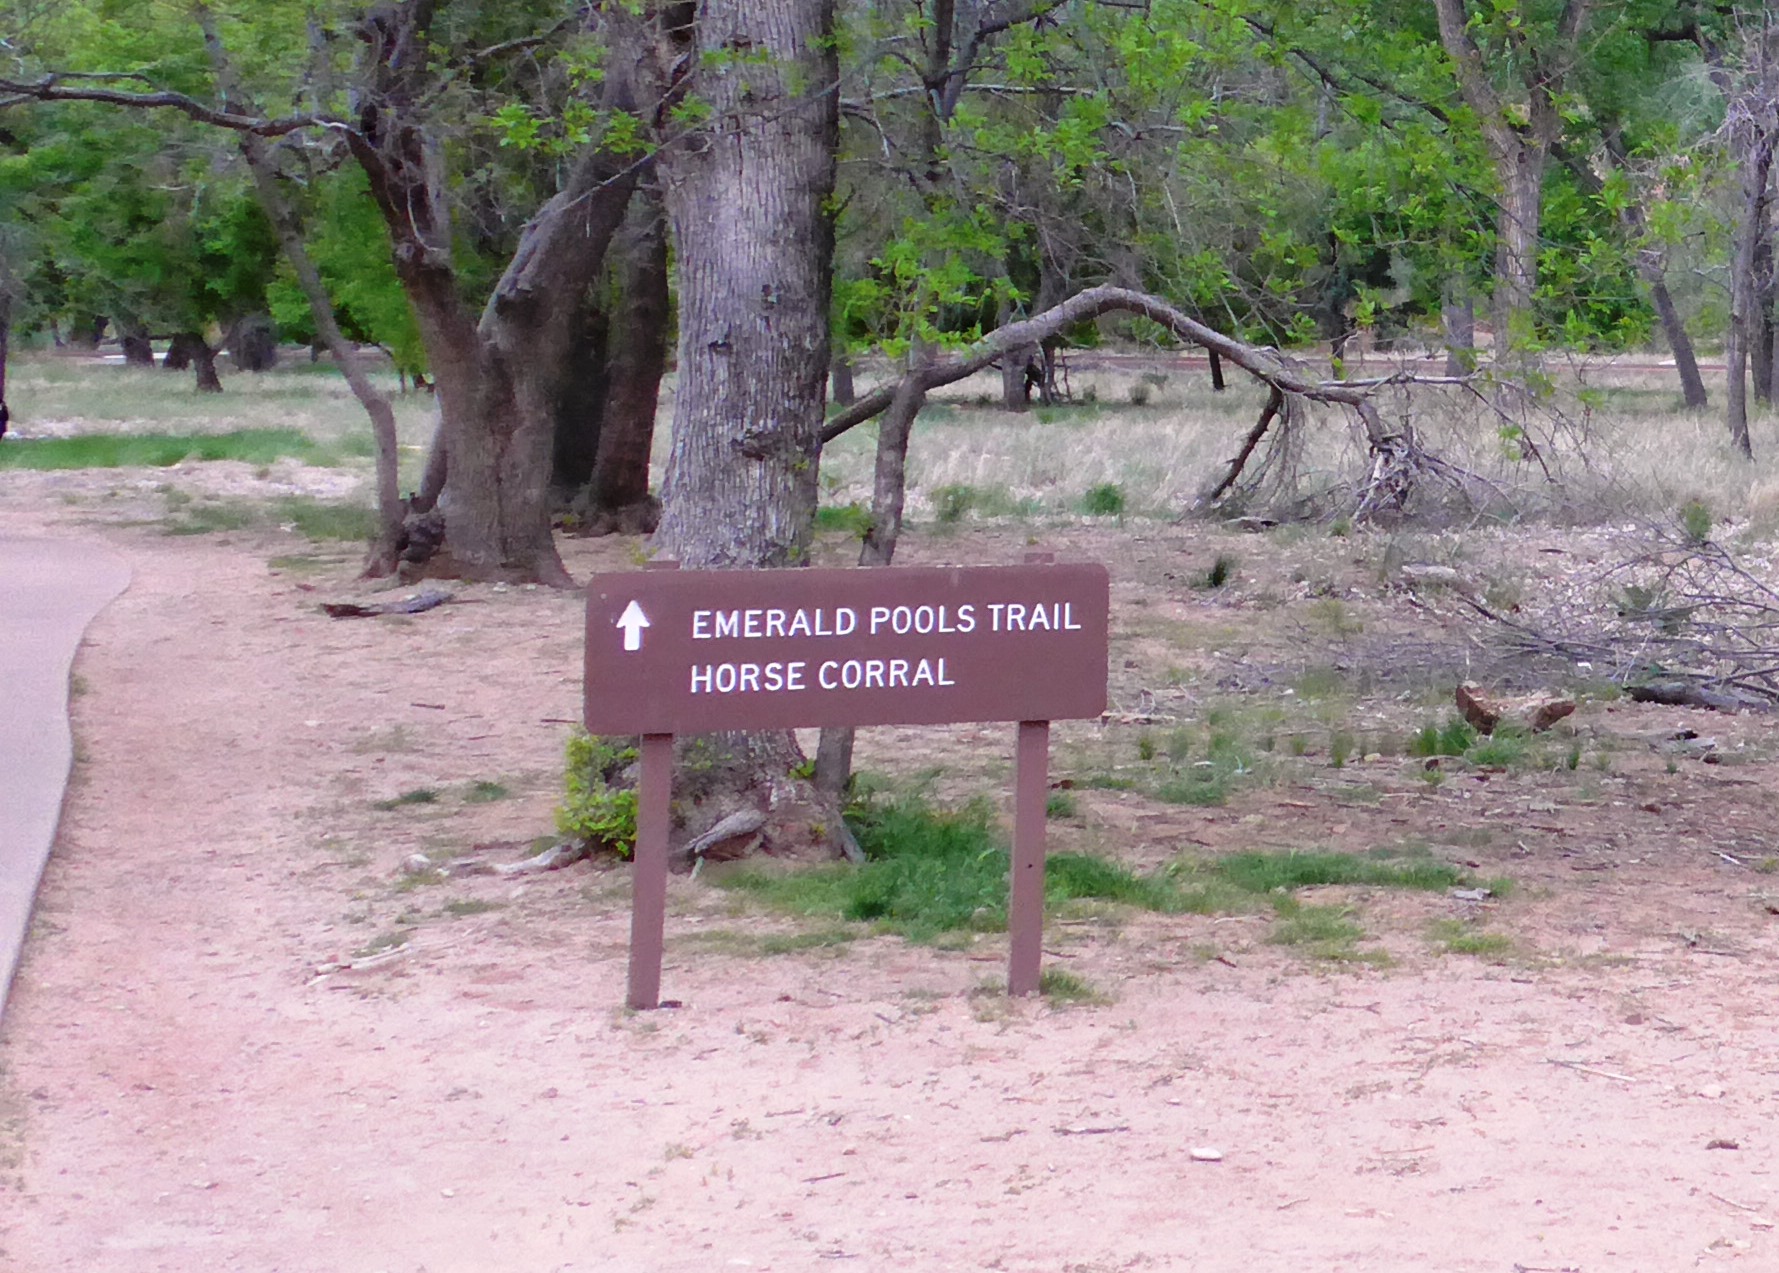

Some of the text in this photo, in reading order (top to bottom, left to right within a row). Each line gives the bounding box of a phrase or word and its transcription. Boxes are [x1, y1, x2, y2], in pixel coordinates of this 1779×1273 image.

[692, 602, 1082, 639] EMERALD POOLS TRAIL
[690, 657, 956, 694] HORSE CORRAL
